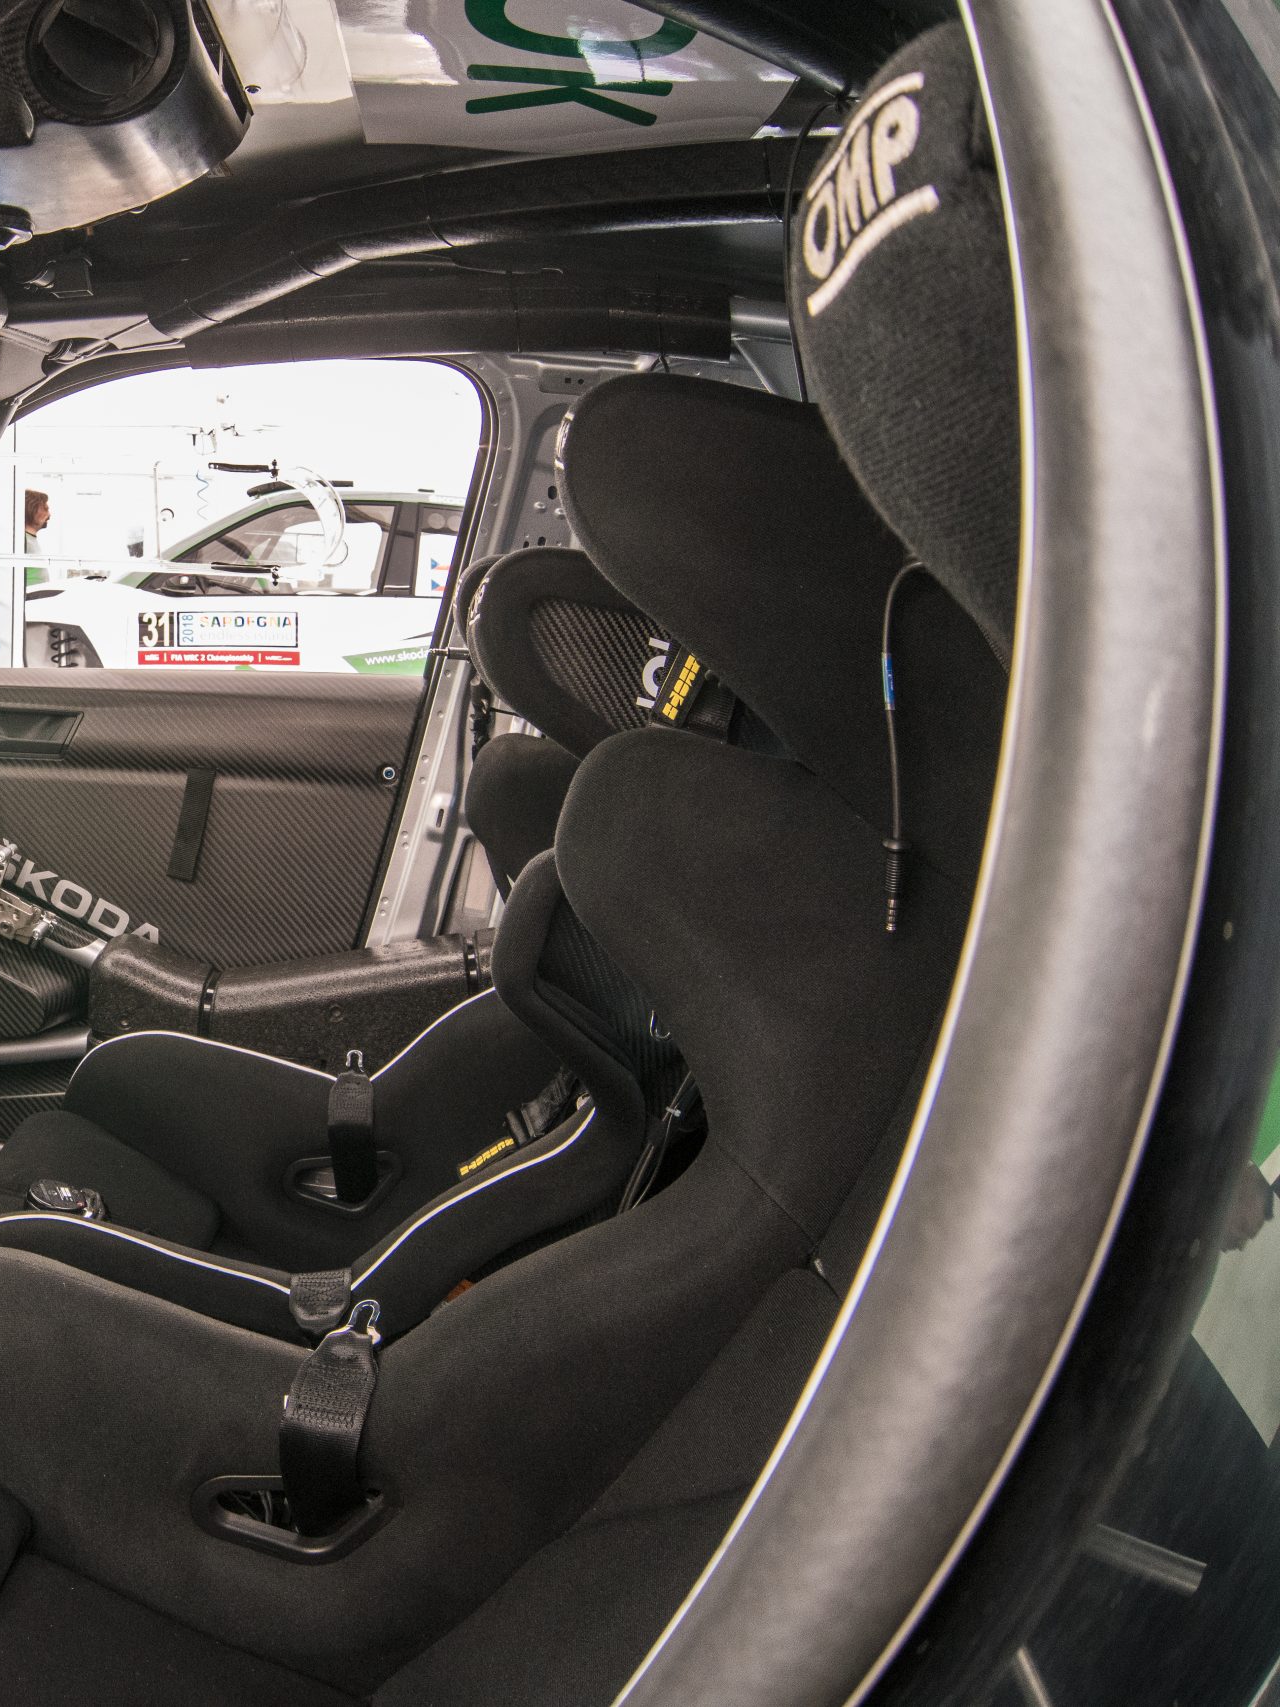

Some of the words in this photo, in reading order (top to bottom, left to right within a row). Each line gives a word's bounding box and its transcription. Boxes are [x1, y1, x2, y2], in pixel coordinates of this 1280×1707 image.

[803, 94, 919, 280] OMP
[142, 612, 172, 648] 31
[181, 614, 195, 643] 2018
